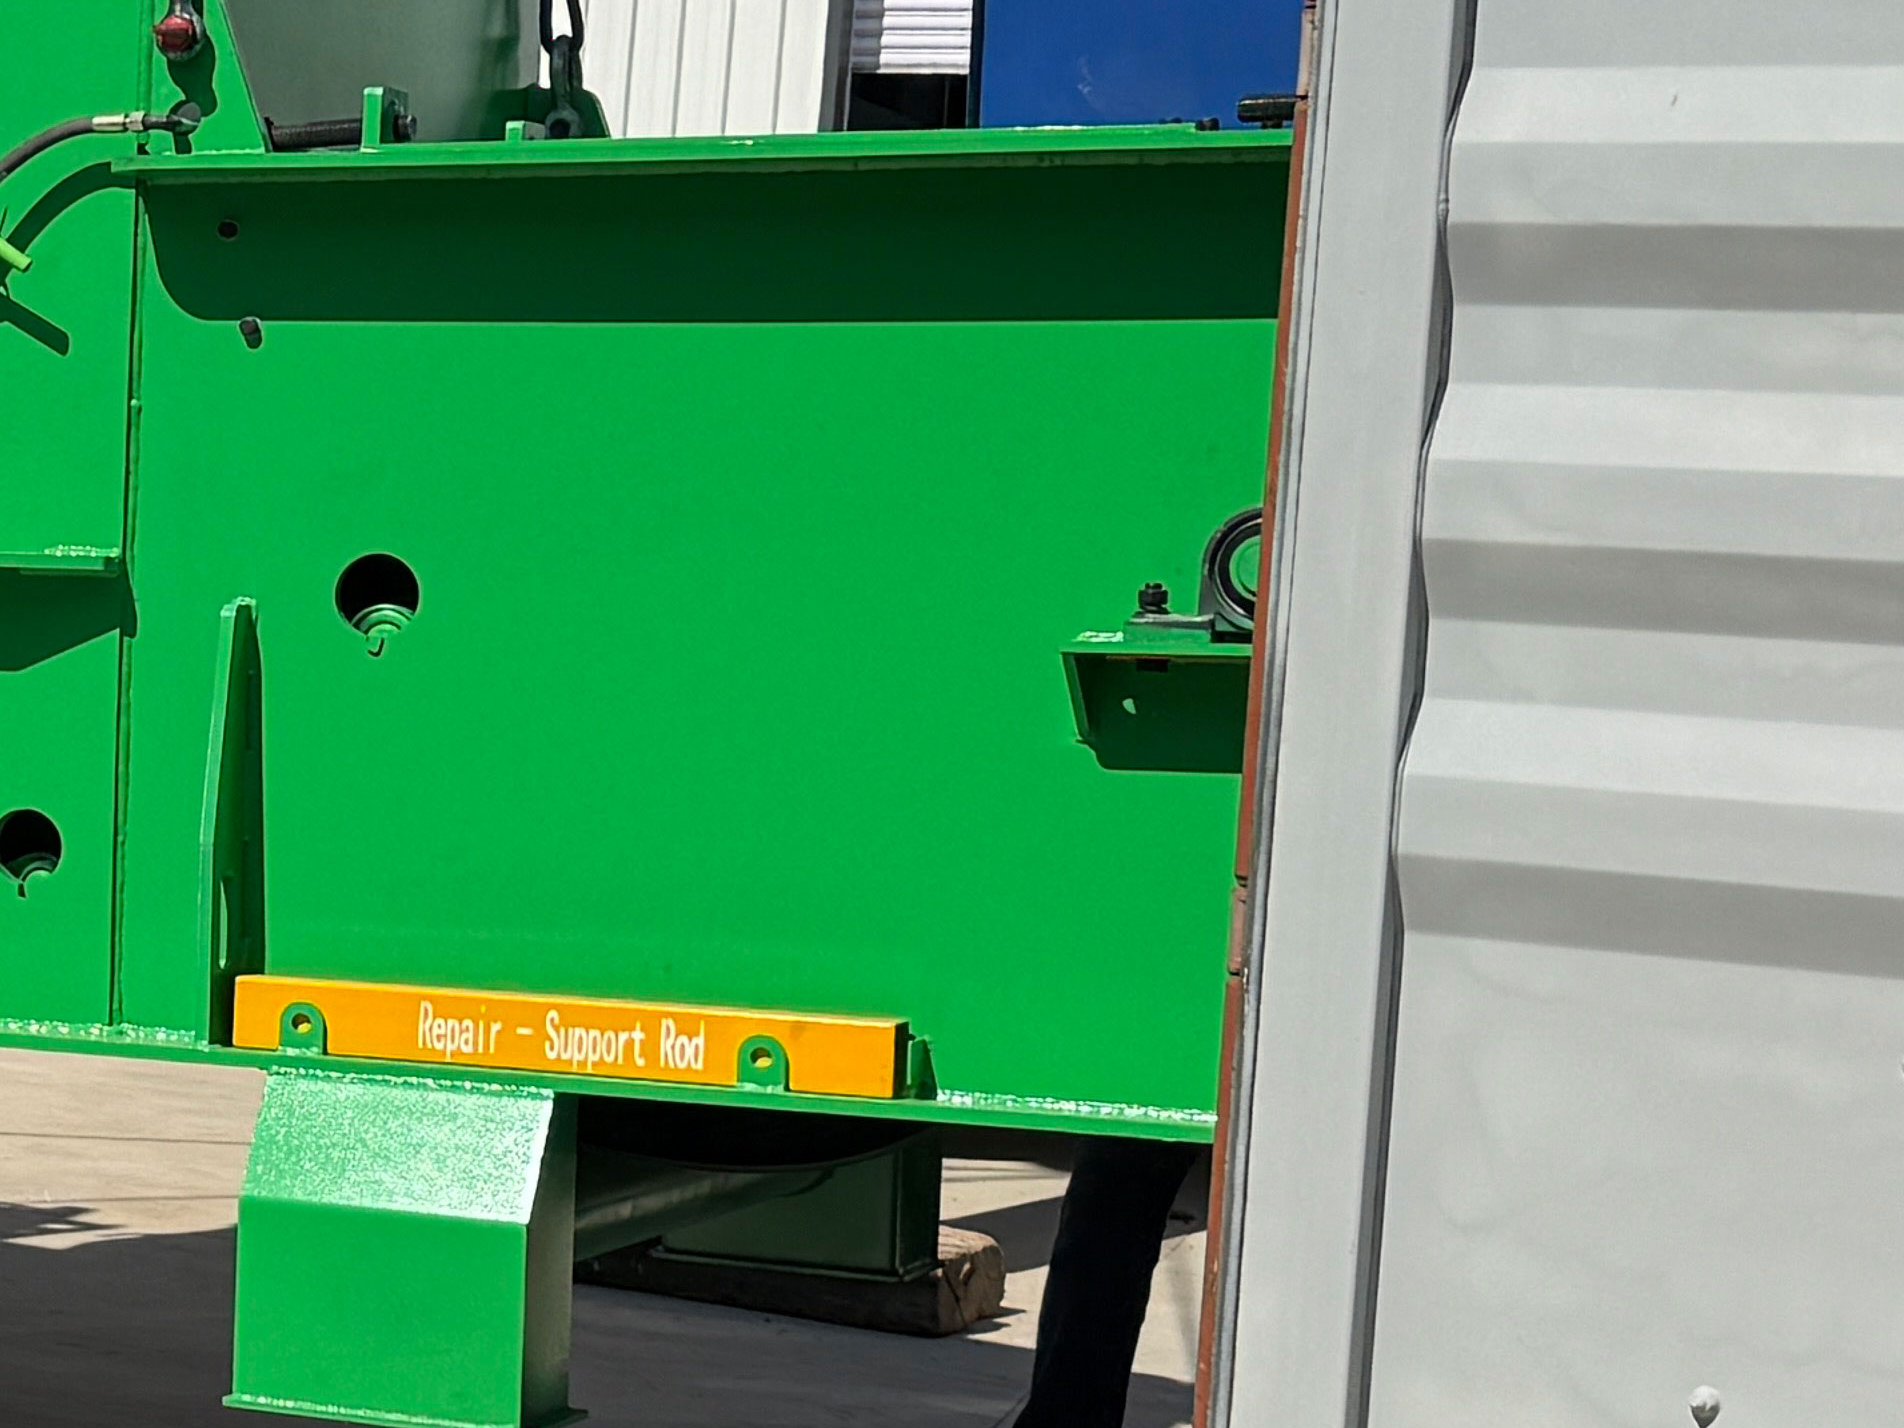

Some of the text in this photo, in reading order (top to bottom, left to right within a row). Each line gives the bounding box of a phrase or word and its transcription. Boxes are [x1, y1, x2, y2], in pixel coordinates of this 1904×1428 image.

[417, 1000, 502, 1063] Repair
[544, 1009, 645, 1073] Support
[659, 1018, 705, 1071] Rod
